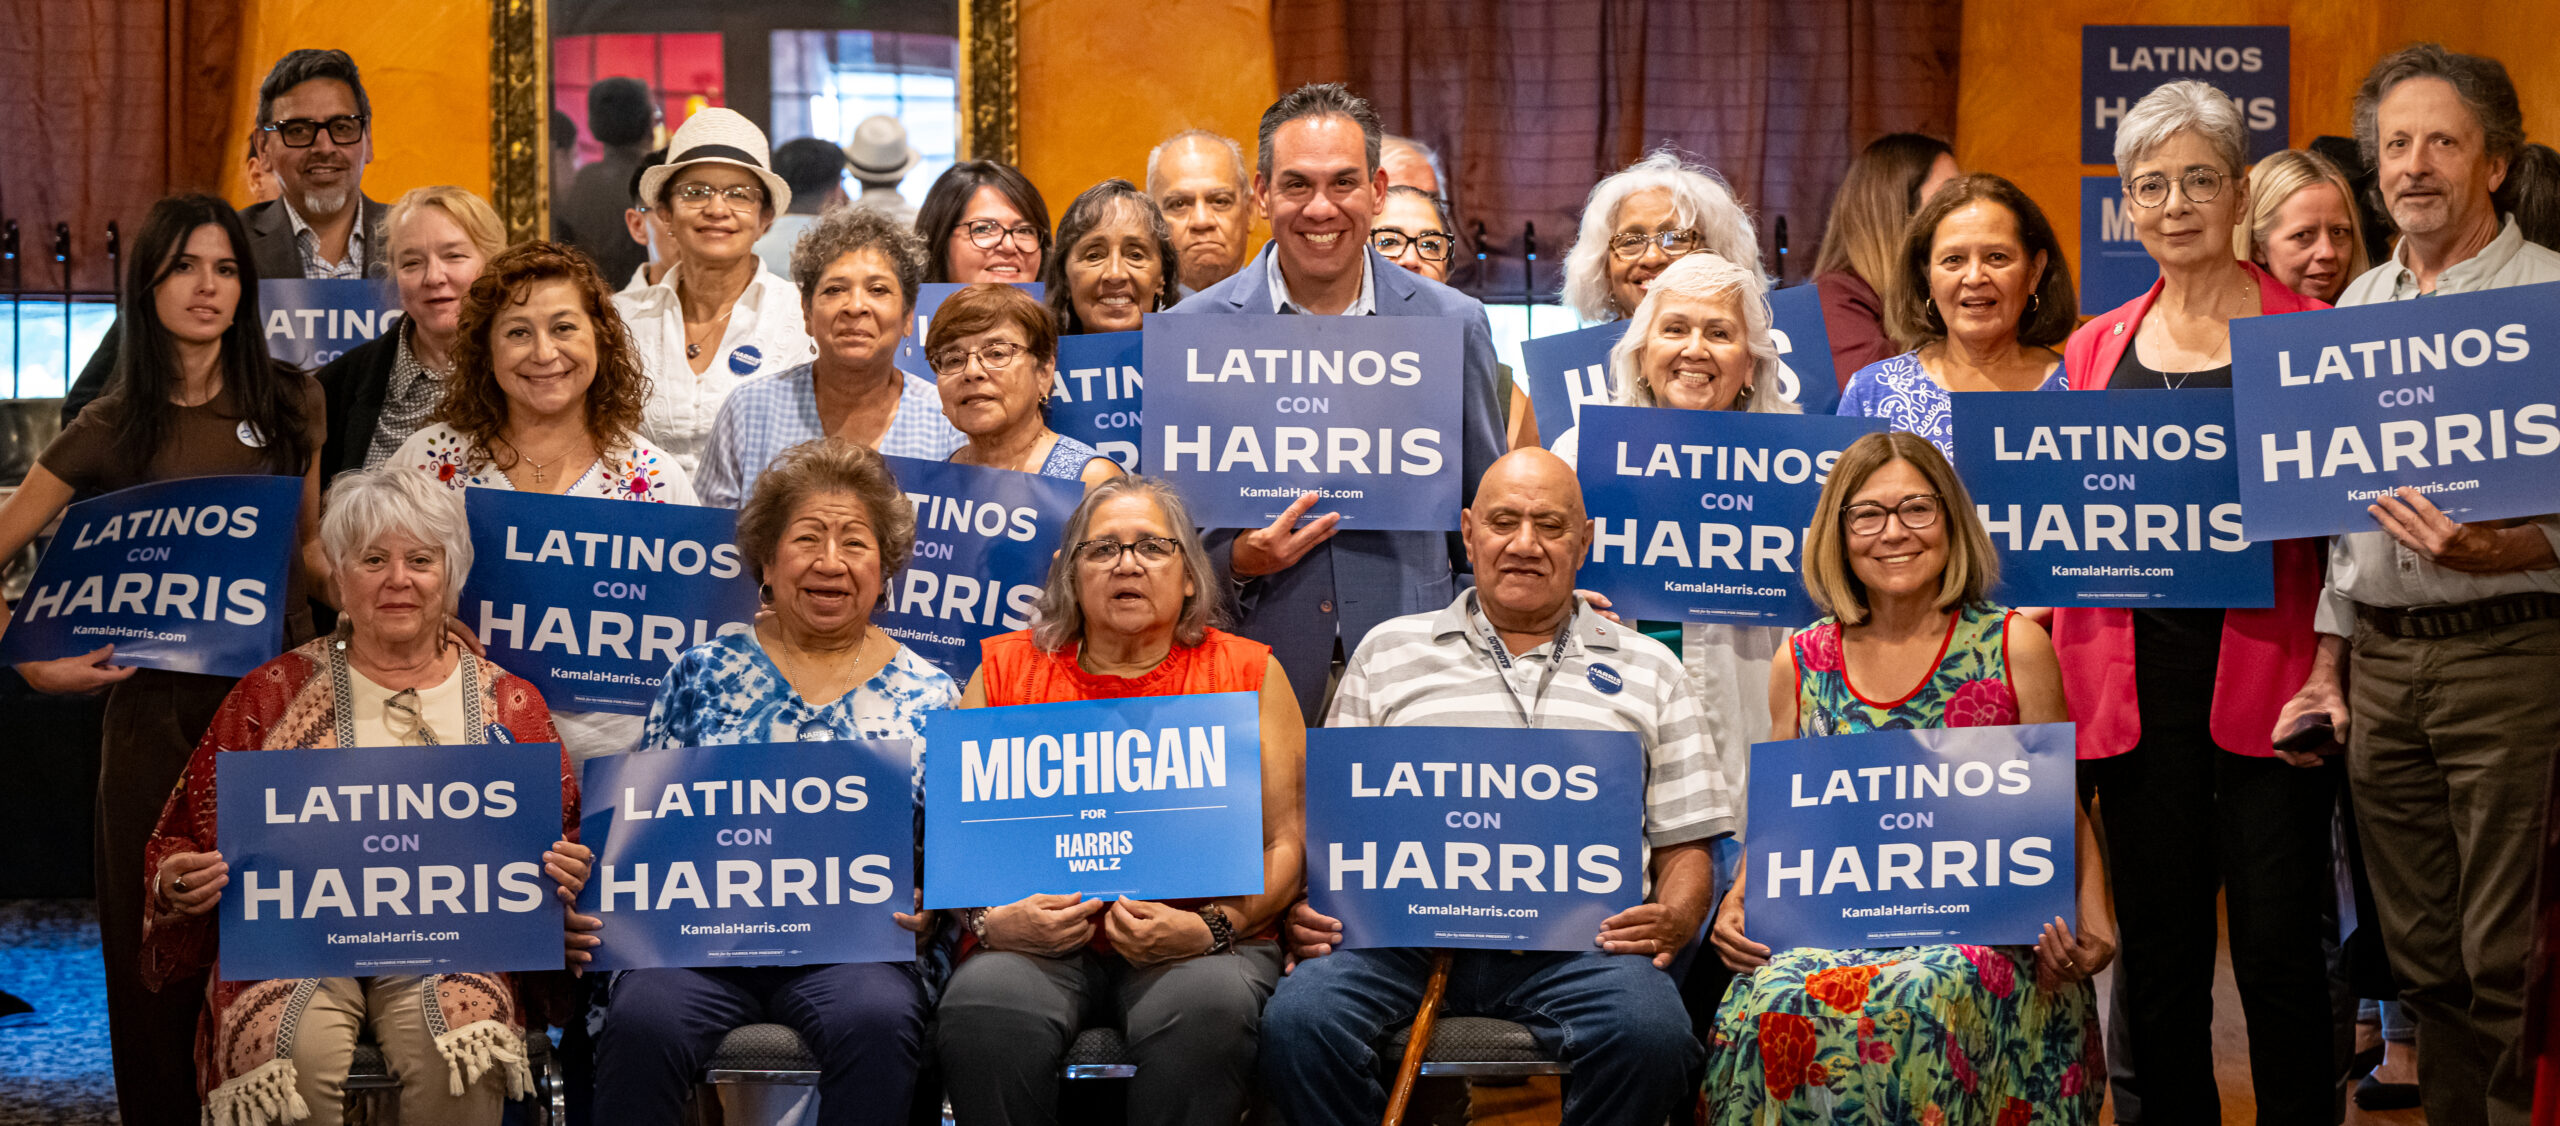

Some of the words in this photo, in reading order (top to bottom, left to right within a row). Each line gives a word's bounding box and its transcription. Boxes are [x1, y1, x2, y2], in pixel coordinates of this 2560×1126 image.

[2109, 47, 2263, 73] LATINOS
[265, 309, 405, 339] ATIN
[1187, 348, 1422, 386] LATINOS
[2278, 323, 2530, 387] LATINOS
[1051, 366, 1144, 403] ATIN
[2378, 385, 2435, 408] CON
[1276, 396, 1329, 414] CON
[1094, 411, 1143, 429] CON
[1164, 425, 1443, 476] HARRIS
[1994, 424, 2227, 461] LATINOS
[2261, 403, 2560, 482] HARRIS
[2083, 473, 2136, 491] CON
[1701, 493, 1754, 511] CON
[73, 505, 259, 550] LATINOS
[905, 492, 1038, 542] TINOS
[1976, 503, 2252, 552] HARRIS
[126, 547, 171, 562] CON
[505, 526, 742, 579] LATINOS
[912, 540, 954, 560] CON
[1593, 516, 1811, 573] HARR
[2051, 565, 2174, 578] KamalaHarris.com
[24, 572, 267, 626] HARRIS
[593, 581, 647, 601] CON
[882, 568, 1045, 632] RRIS
[1664, 580, 1787, 598] KamalaHarris.com
[72, 625, 187, 643] KamalaHarris.com
[479, 600, 752, 663] HARRI
[876, 624, 966, 647] malaHarris.com
[1552, 629, 1571, 663] COWBOY
[1487, 635, 1512, 669] COWBOYS
[551, 667, 661, 687] KamalaHarris.co
[1590, 666, 1621, 684] HARRIS
[961, 725, 1227, 802] MICHIGAN
[1351, 762, 1598, 801] LATINOS
[1791, 759, 2031, 808] LATINOS
[265, 780, 518, 824] LATINOS
[624, 775, 868, 821] LATINOS
[1080, 808, 1107, 820] FOR
[1445, 811, 1501, 829] CON
[1879, 811, 1934, 830] CON
[363, 834, 420, 853] CON
[716, 828, 772, 846] CON
[1055, 830, 1133, 858] HARRIS
[1069, 857, 1121, 872] WALZ
[1329, 841, 1623, 894] HARRIS
[1767, 836, 2055, 899] HARRIS
[243, 861, 543, 921] HARRIS
[601, 854, 894, 912] HARRIS
[1408, 904, 1539, 919] KamalaHarris.com
[1842, 903, 1970, 919] KamalaHarris.com
[327, 930, 460, 945] KamalaHarris.com
[681, 921, 811, 936] KamalaHarris.com
